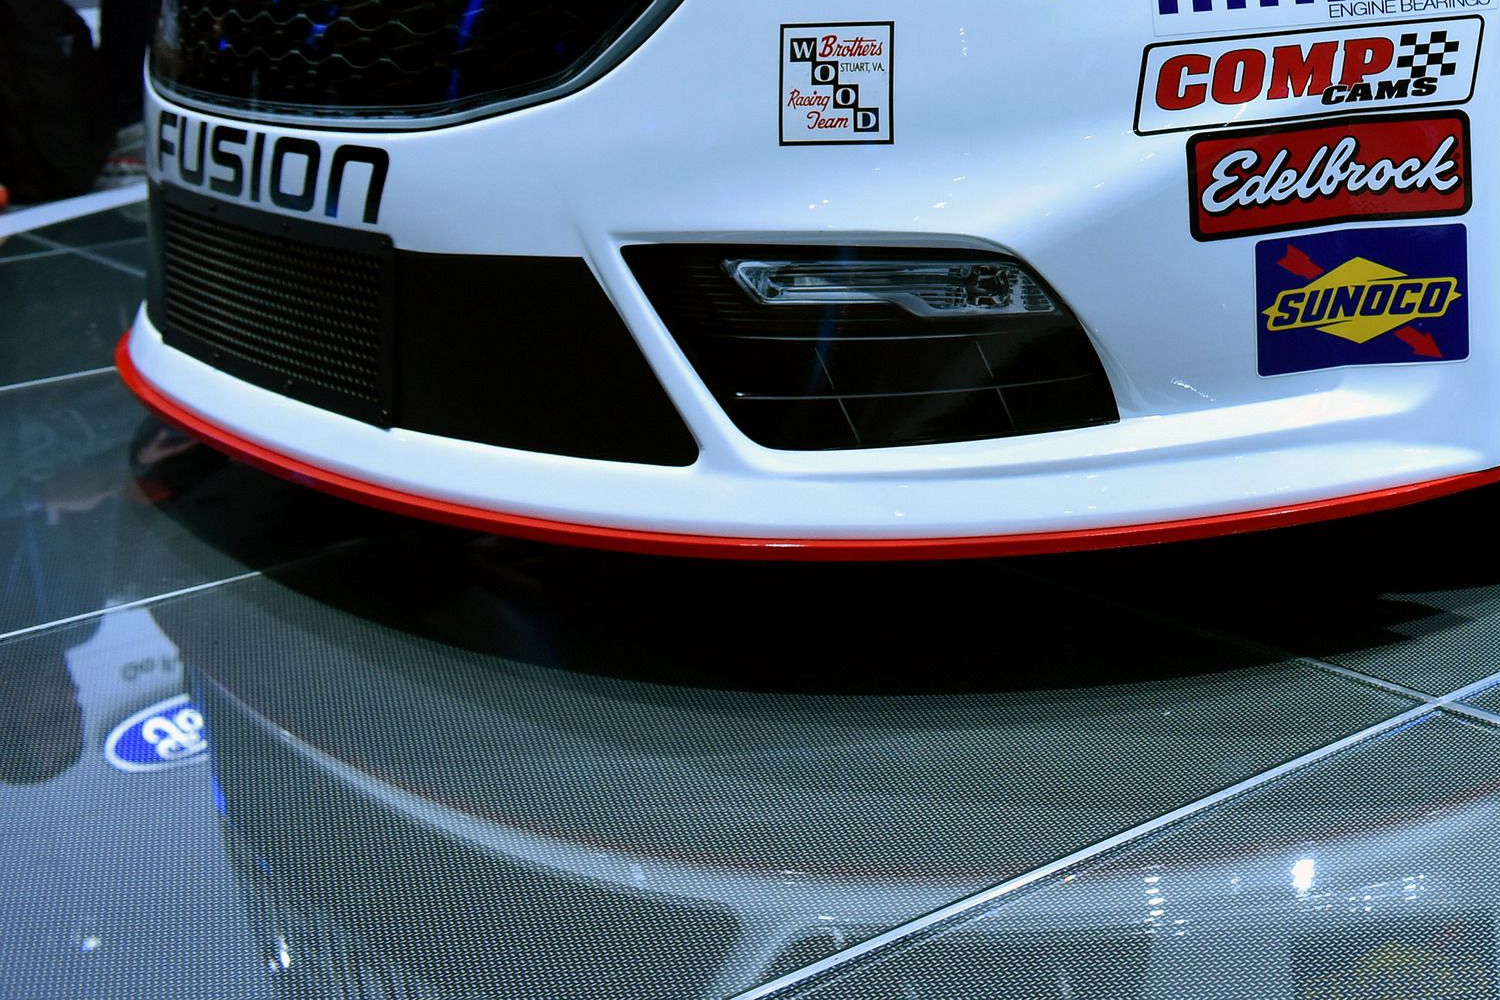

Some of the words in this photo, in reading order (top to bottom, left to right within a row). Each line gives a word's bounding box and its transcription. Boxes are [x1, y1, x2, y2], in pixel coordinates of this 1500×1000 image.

[1329, 0, 1396, 19] ENGINE
[819, 35, 883, 58] Brothers
[840, 62, 870, 74] STUART,
[1155, 37, 1395, 111] COMP
[787, 88, 831, 112] Racing
[1321, 76, 1438, 106] CAMS
[806, 111, 849, 129] Team
[157, 110, 390, 225] FUSION
[1202, 136, 1459, 213] Edelbrock
[1272, 281, 1453, 328] SUNOCO
